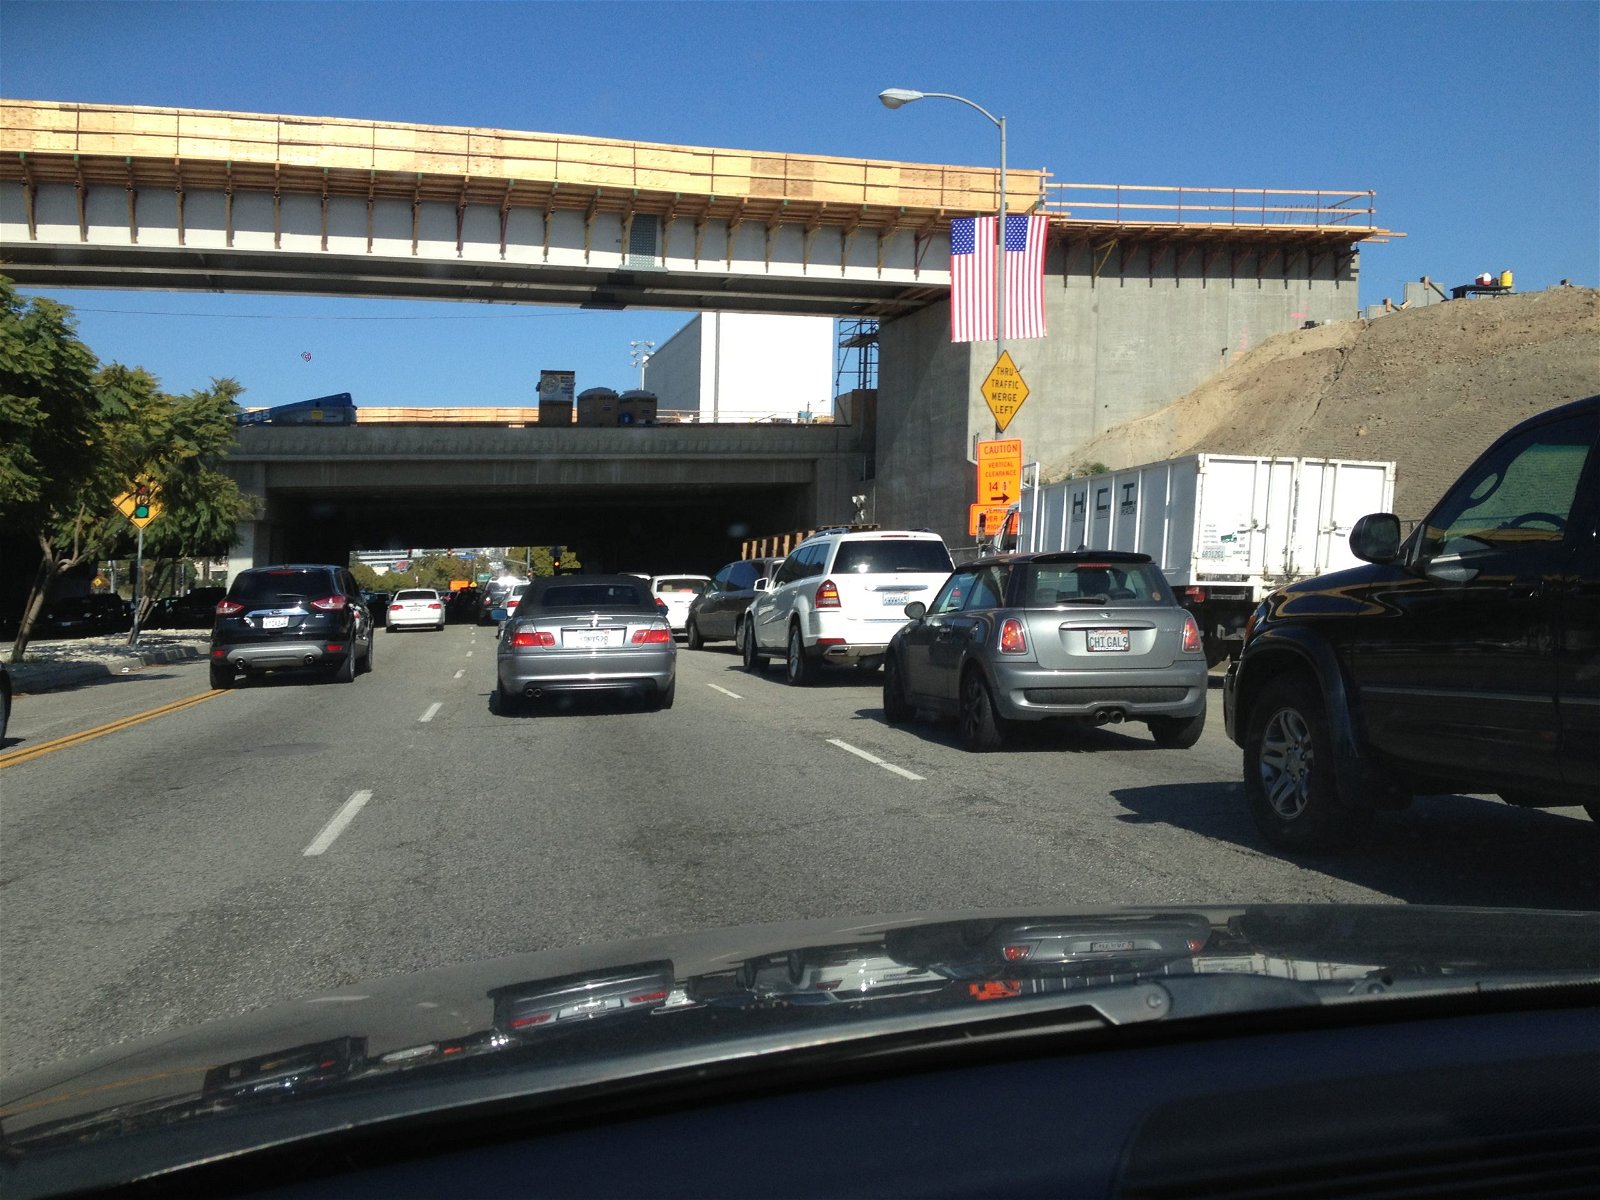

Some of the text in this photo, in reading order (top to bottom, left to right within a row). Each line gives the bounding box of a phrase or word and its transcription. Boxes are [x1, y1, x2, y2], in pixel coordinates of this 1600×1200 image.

[996, 366, 1014, 377] THRU
[991, 378, 1019, 390] TRAFFIC
[991, 392, 1017, 402] MERGE
[995, 405, 1014, 415] LEFT
[983, 444, 1018, 455] CAUTION
[988, 461, 1014, 469] VERTICAL
[985, 469, 1017, 478] CLEARANCE
